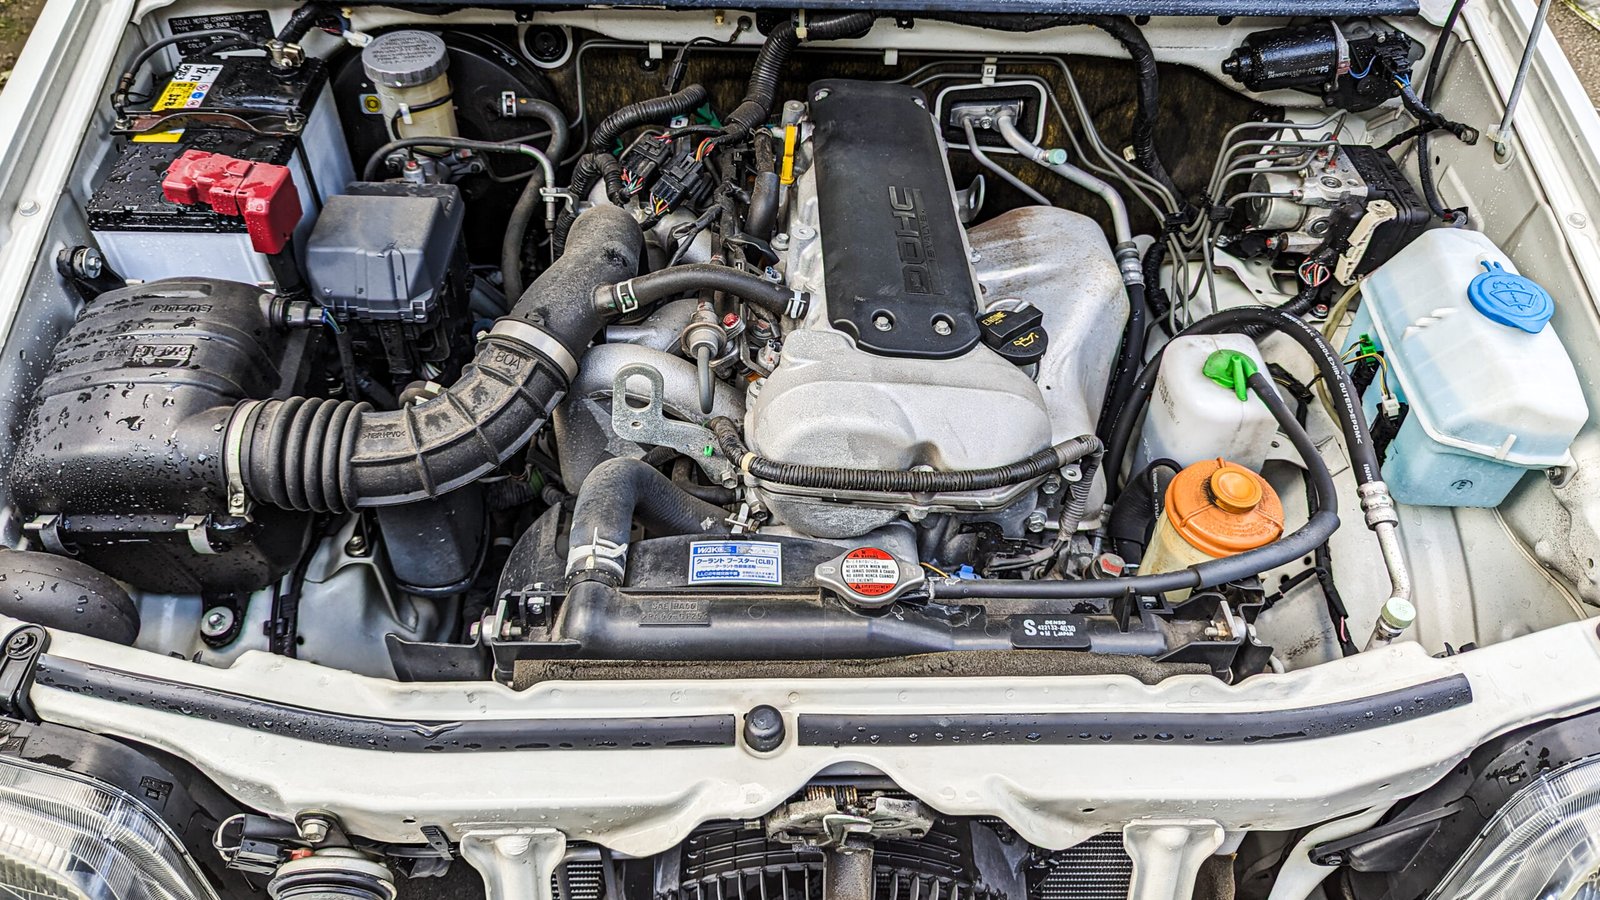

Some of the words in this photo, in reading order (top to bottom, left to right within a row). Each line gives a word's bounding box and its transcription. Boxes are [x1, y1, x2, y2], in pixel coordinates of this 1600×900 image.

[888, 186, 931, 294] DOHC
[150, 304, 213, 313] SUZUKI
[981, 311, 1007, 326] ENGINE
[495, 351, 521, 370] 80A
[1023, 619, 1037, 636] S
